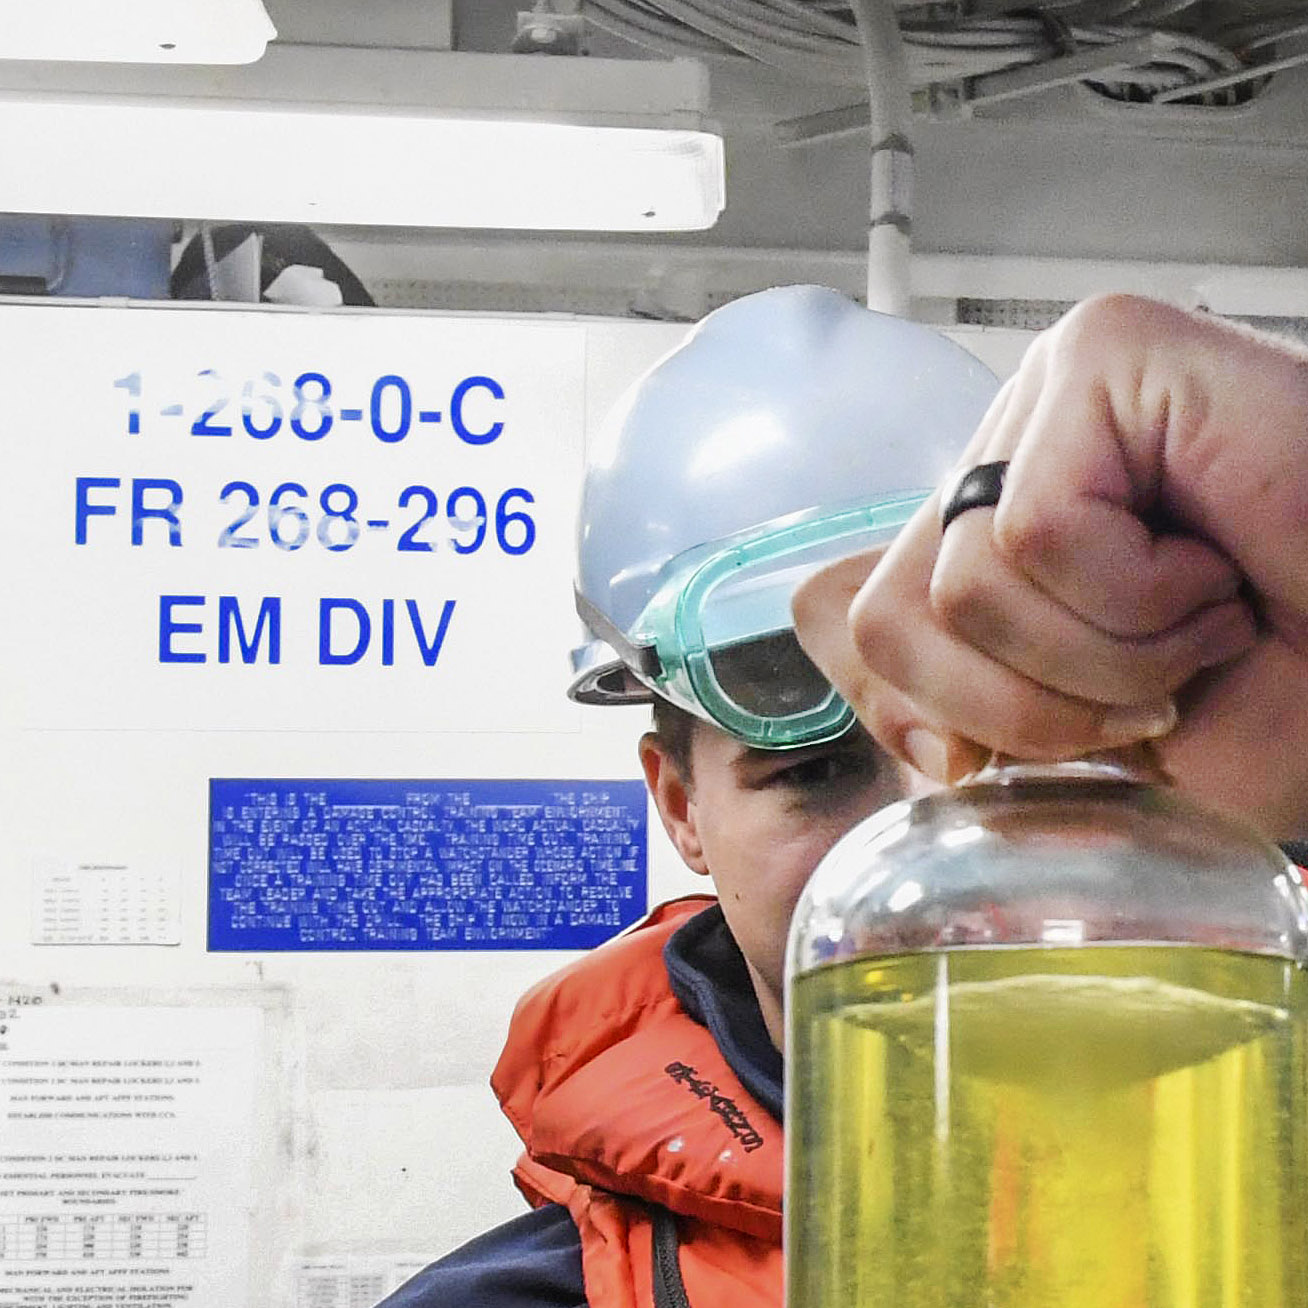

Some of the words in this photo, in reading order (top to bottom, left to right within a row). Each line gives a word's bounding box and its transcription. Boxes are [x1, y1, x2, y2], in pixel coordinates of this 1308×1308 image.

[114, 369, 507, 447] 1-268-0-C
[74, 476, 185, 548] FR
[218, 479, 537, 557] 268-296
[158, 594, 283, 666] EM
[318, 597, 457, 668] DIV
